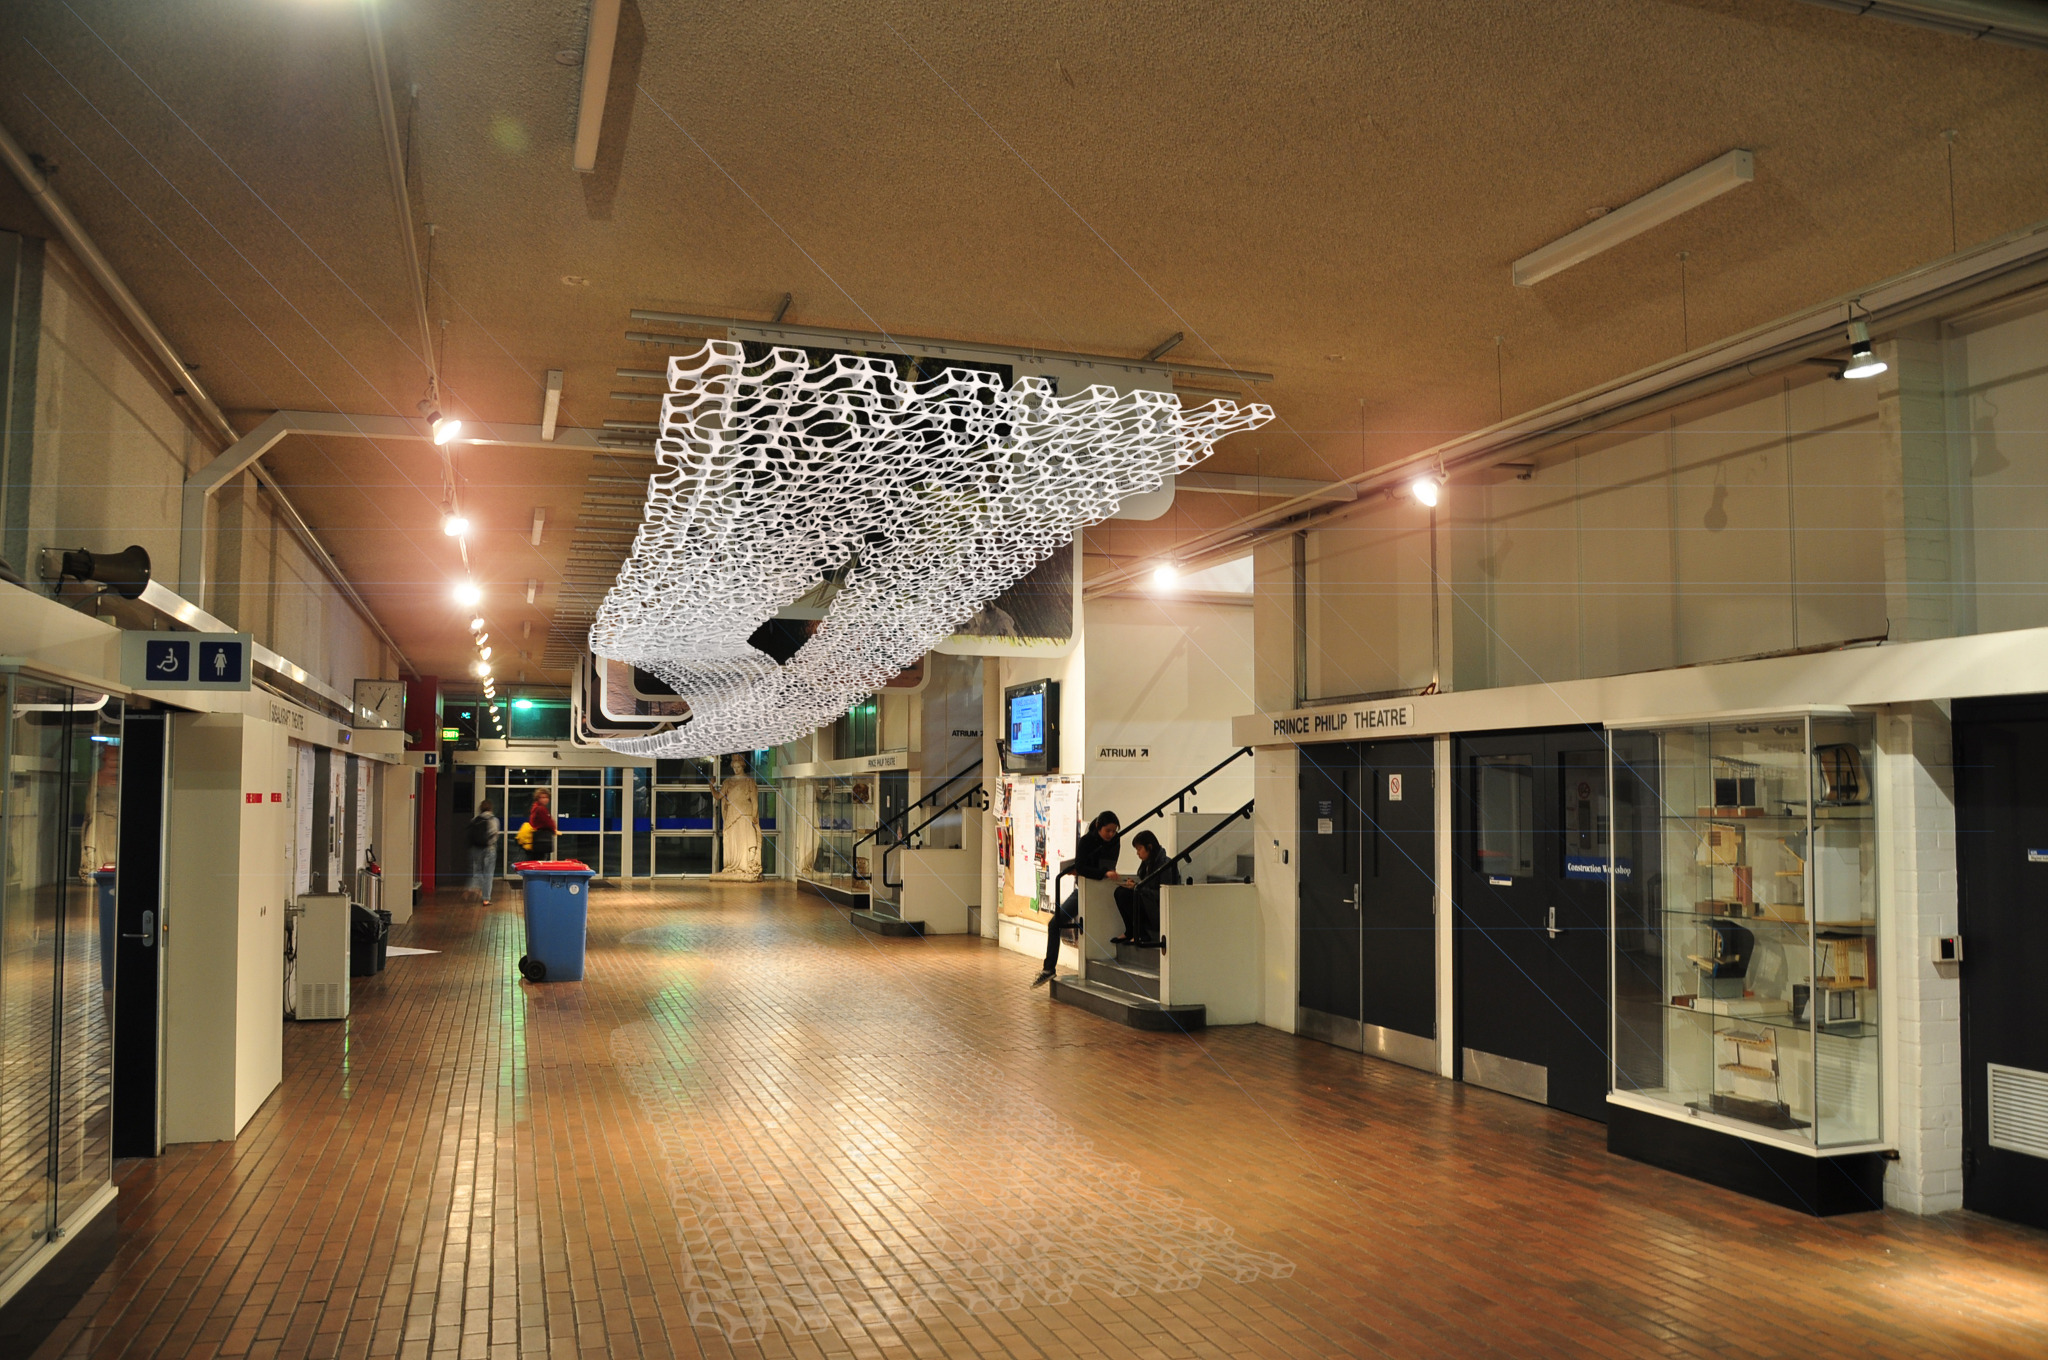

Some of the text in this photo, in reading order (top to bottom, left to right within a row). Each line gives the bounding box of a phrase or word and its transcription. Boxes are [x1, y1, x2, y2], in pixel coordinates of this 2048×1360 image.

[1273, 707, 1407, 736] PRINCE PHILIP THEATRE
[443, 730, 456, 738] EXIT
[951, 729, 978, 737] ATRIUM
[1099, 748, 1137, 758] ATRIUM
[1567, 862, 1631, 877] Construction Wokshop
